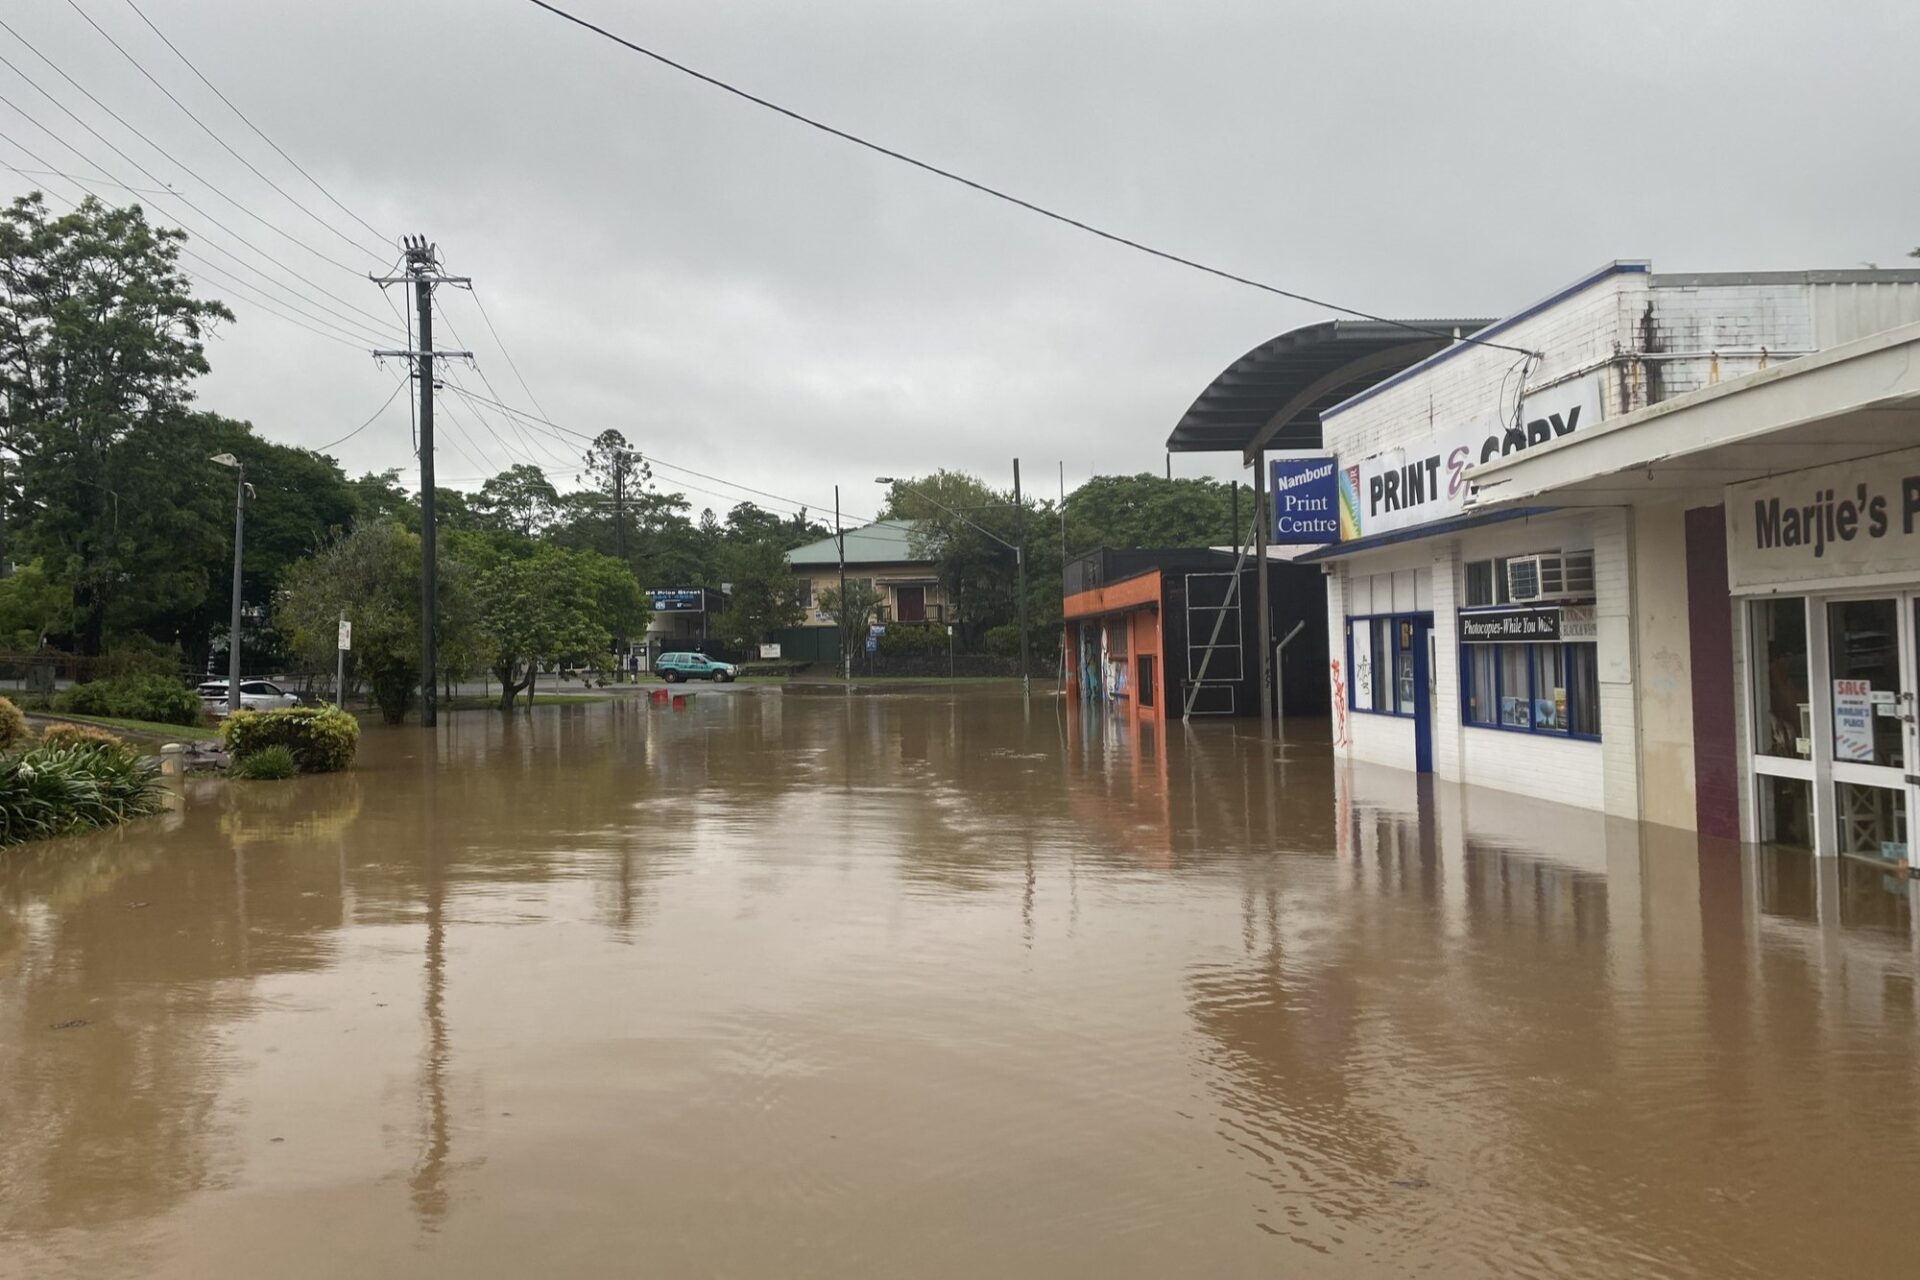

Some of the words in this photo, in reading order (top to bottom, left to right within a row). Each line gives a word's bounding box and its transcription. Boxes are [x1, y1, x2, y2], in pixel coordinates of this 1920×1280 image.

[1278, 463, 1333, 491] Nambour
[1370, 454, 1441, 517] PRINT
[1284, 494, 1328, 511] Print
[1278, 516, 1337, 533] Centre
[1754, 482, 1888, 558] Marjie's
[1522, 616, 1536, 633] You
[1837, 680, 1867, 696] SALE
